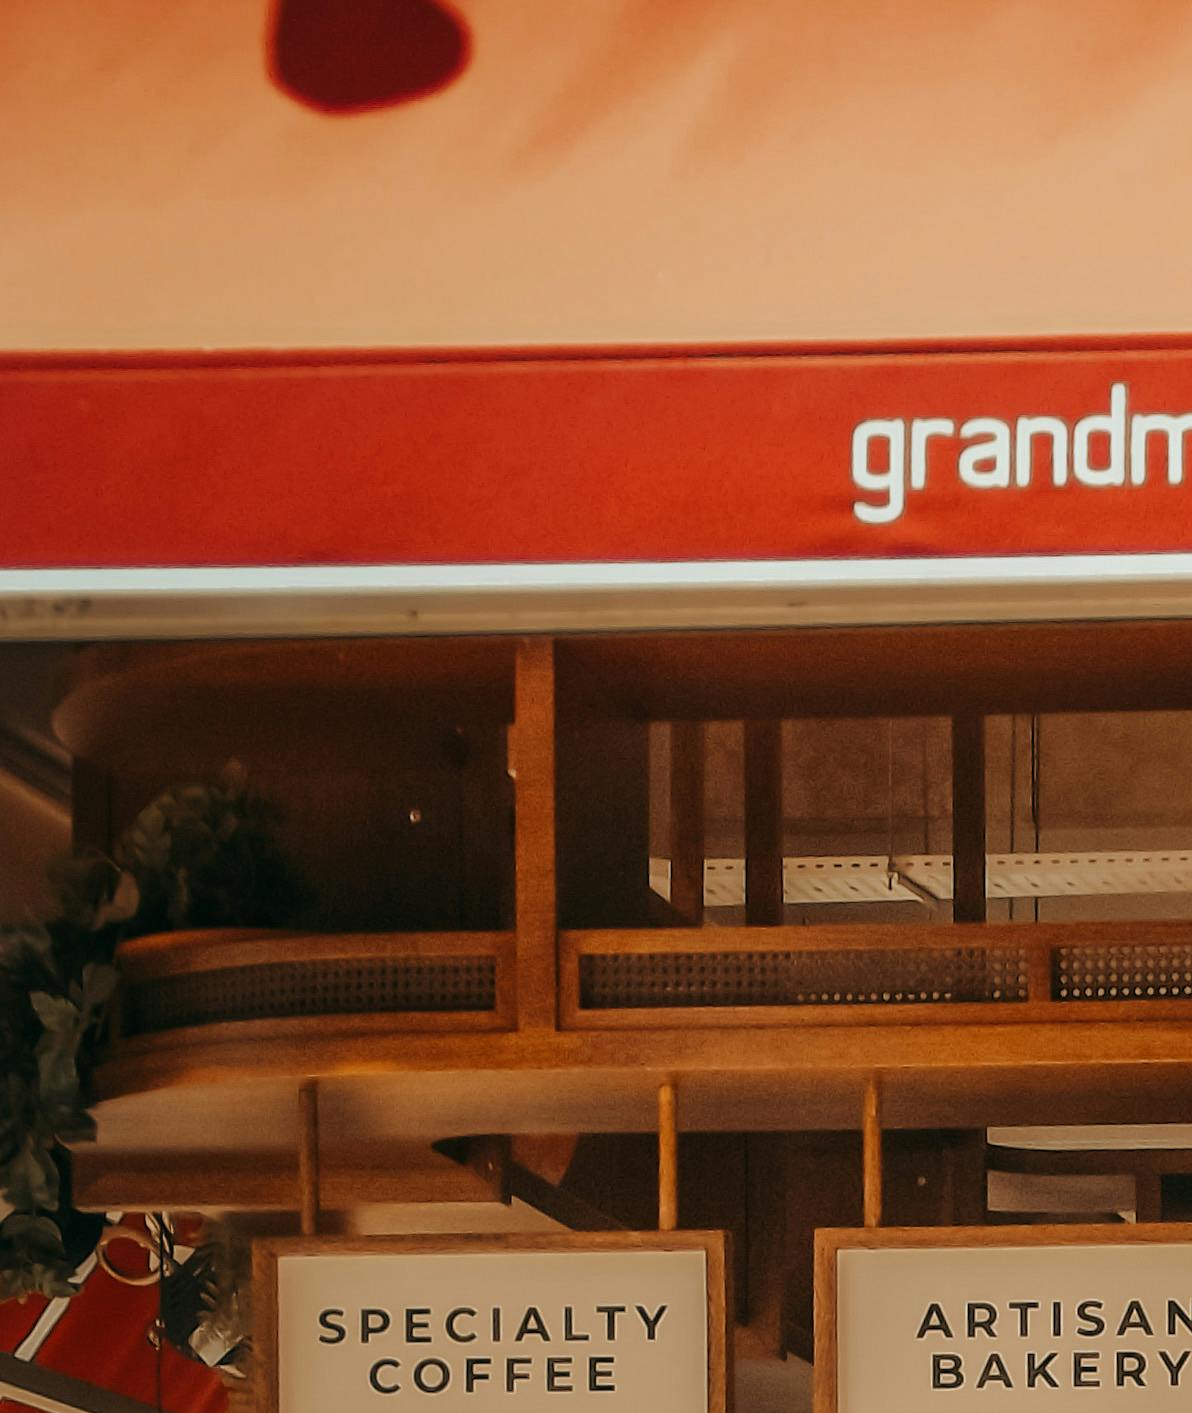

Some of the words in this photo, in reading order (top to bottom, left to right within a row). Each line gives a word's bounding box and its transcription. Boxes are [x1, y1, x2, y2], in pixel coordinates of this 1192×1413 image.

[318, 1305, 669, 1345] SPECIALTY
[369, 1356, 617, 1394] COFFEE
[932, 1350, 1192, 1390] BAKERY
